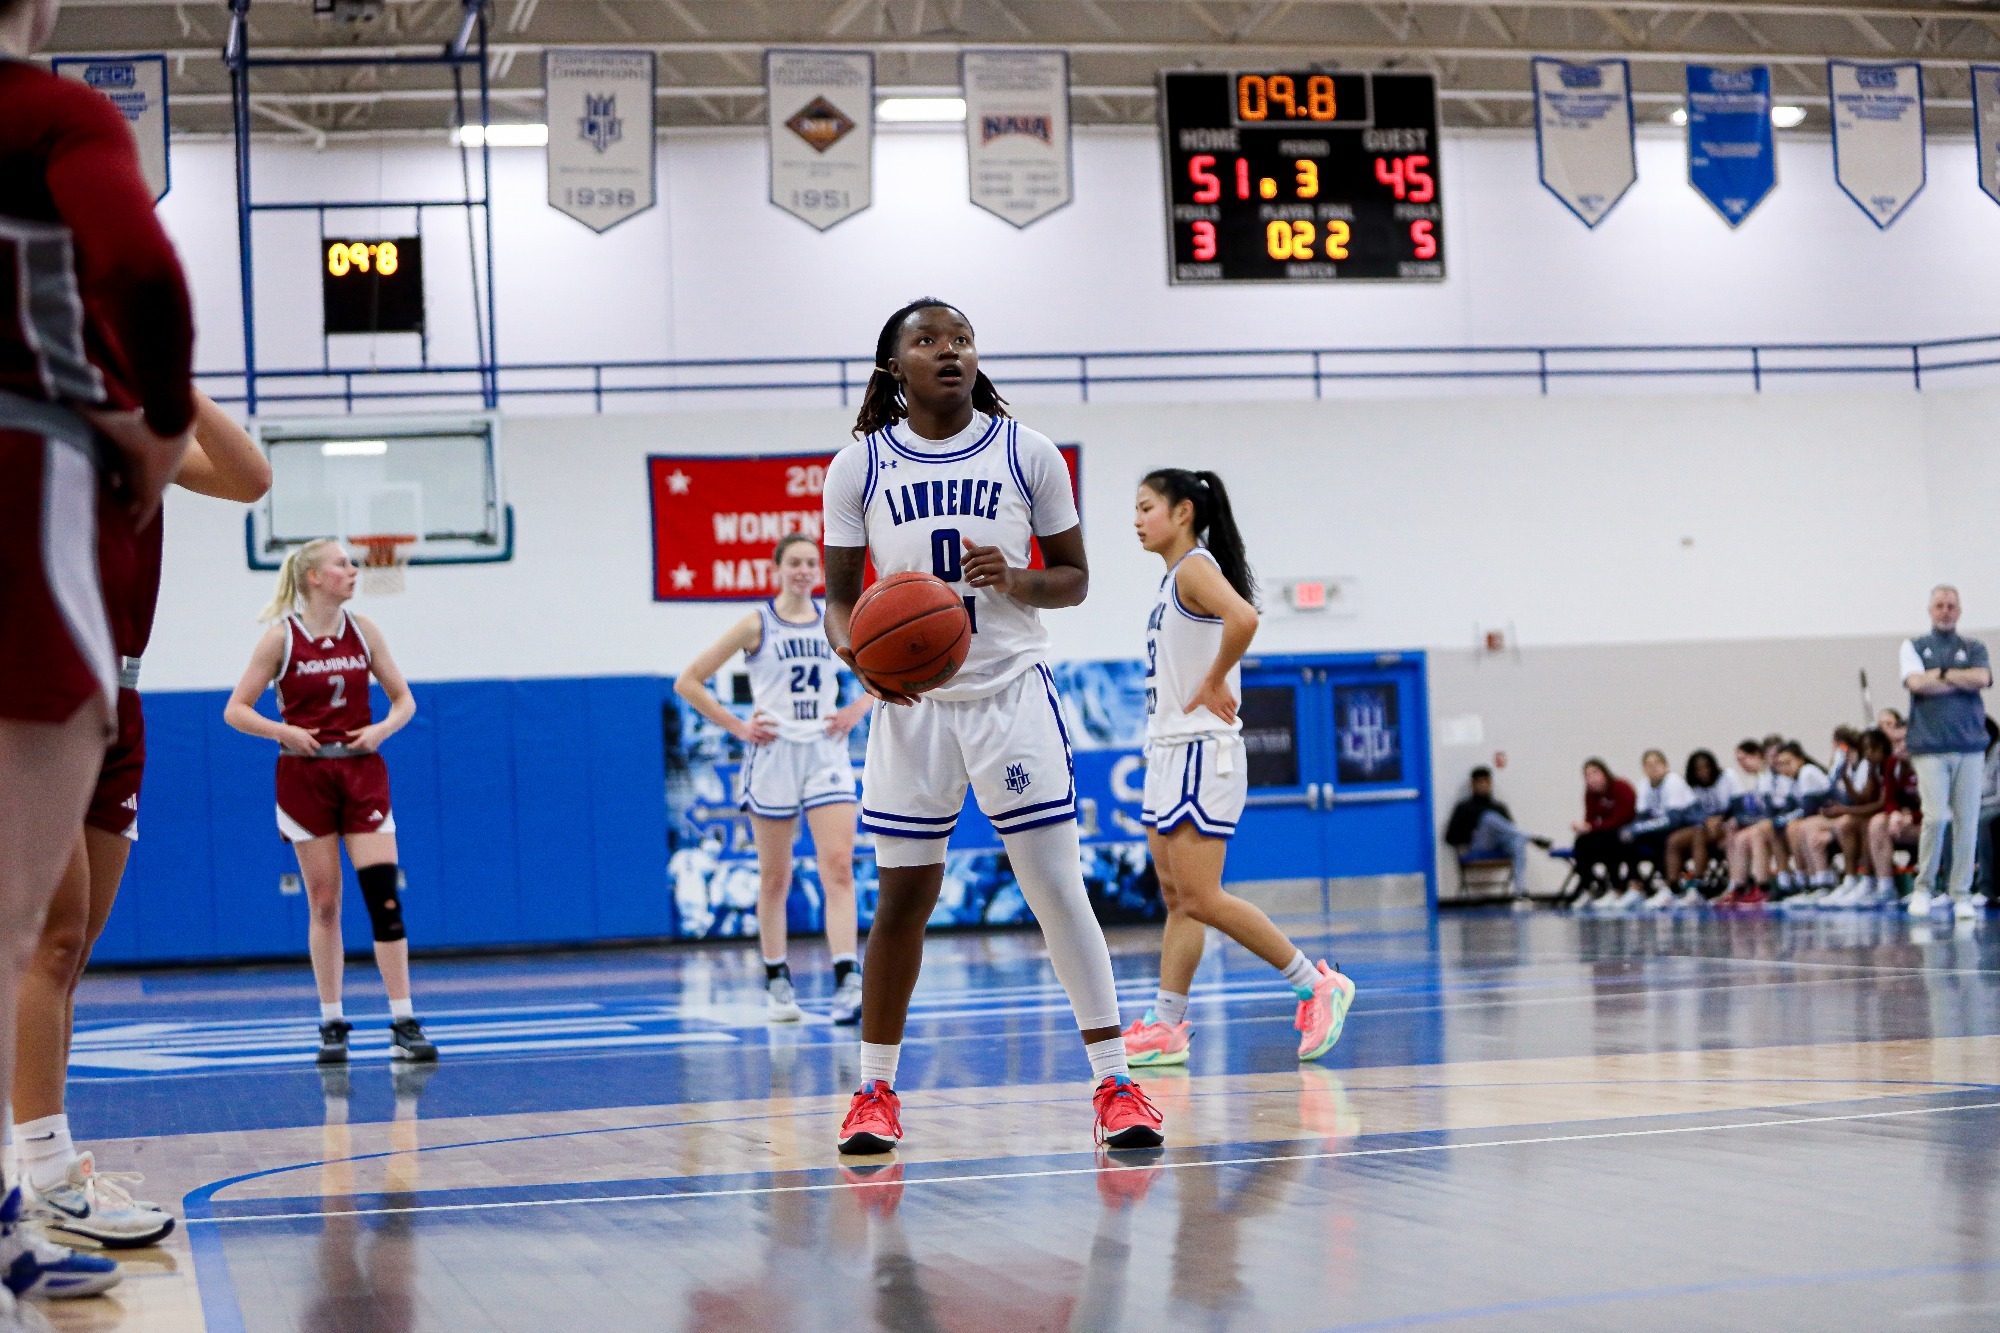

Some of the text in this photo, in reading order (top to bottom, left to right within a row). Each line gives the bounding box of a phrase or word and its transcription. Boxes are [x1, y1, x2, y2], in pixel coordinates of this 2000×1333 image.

[1237, 75, 1337, 121] 09.8
[980, 115, 1052, 146] NAIA
[1179, 127, 1240, 151] HOME
[1362, 127, 1429, 151] GUEST
[1294, 159, 1319, 198] 3
[1374, 155, 1435, 203] 45
[791, 189, 850, 208] 1951
[1191, 220, 1217, 261] 3
[1410, 219, 1437, 260] 5
[885, 478, 1003, 527] LAWRENCE
[930, 528, 963, 583] 0
[296, 655, 367, 677] AQUINAS
[790, 663, 822, 693] 24
[328, 675, 347, 708] 2
